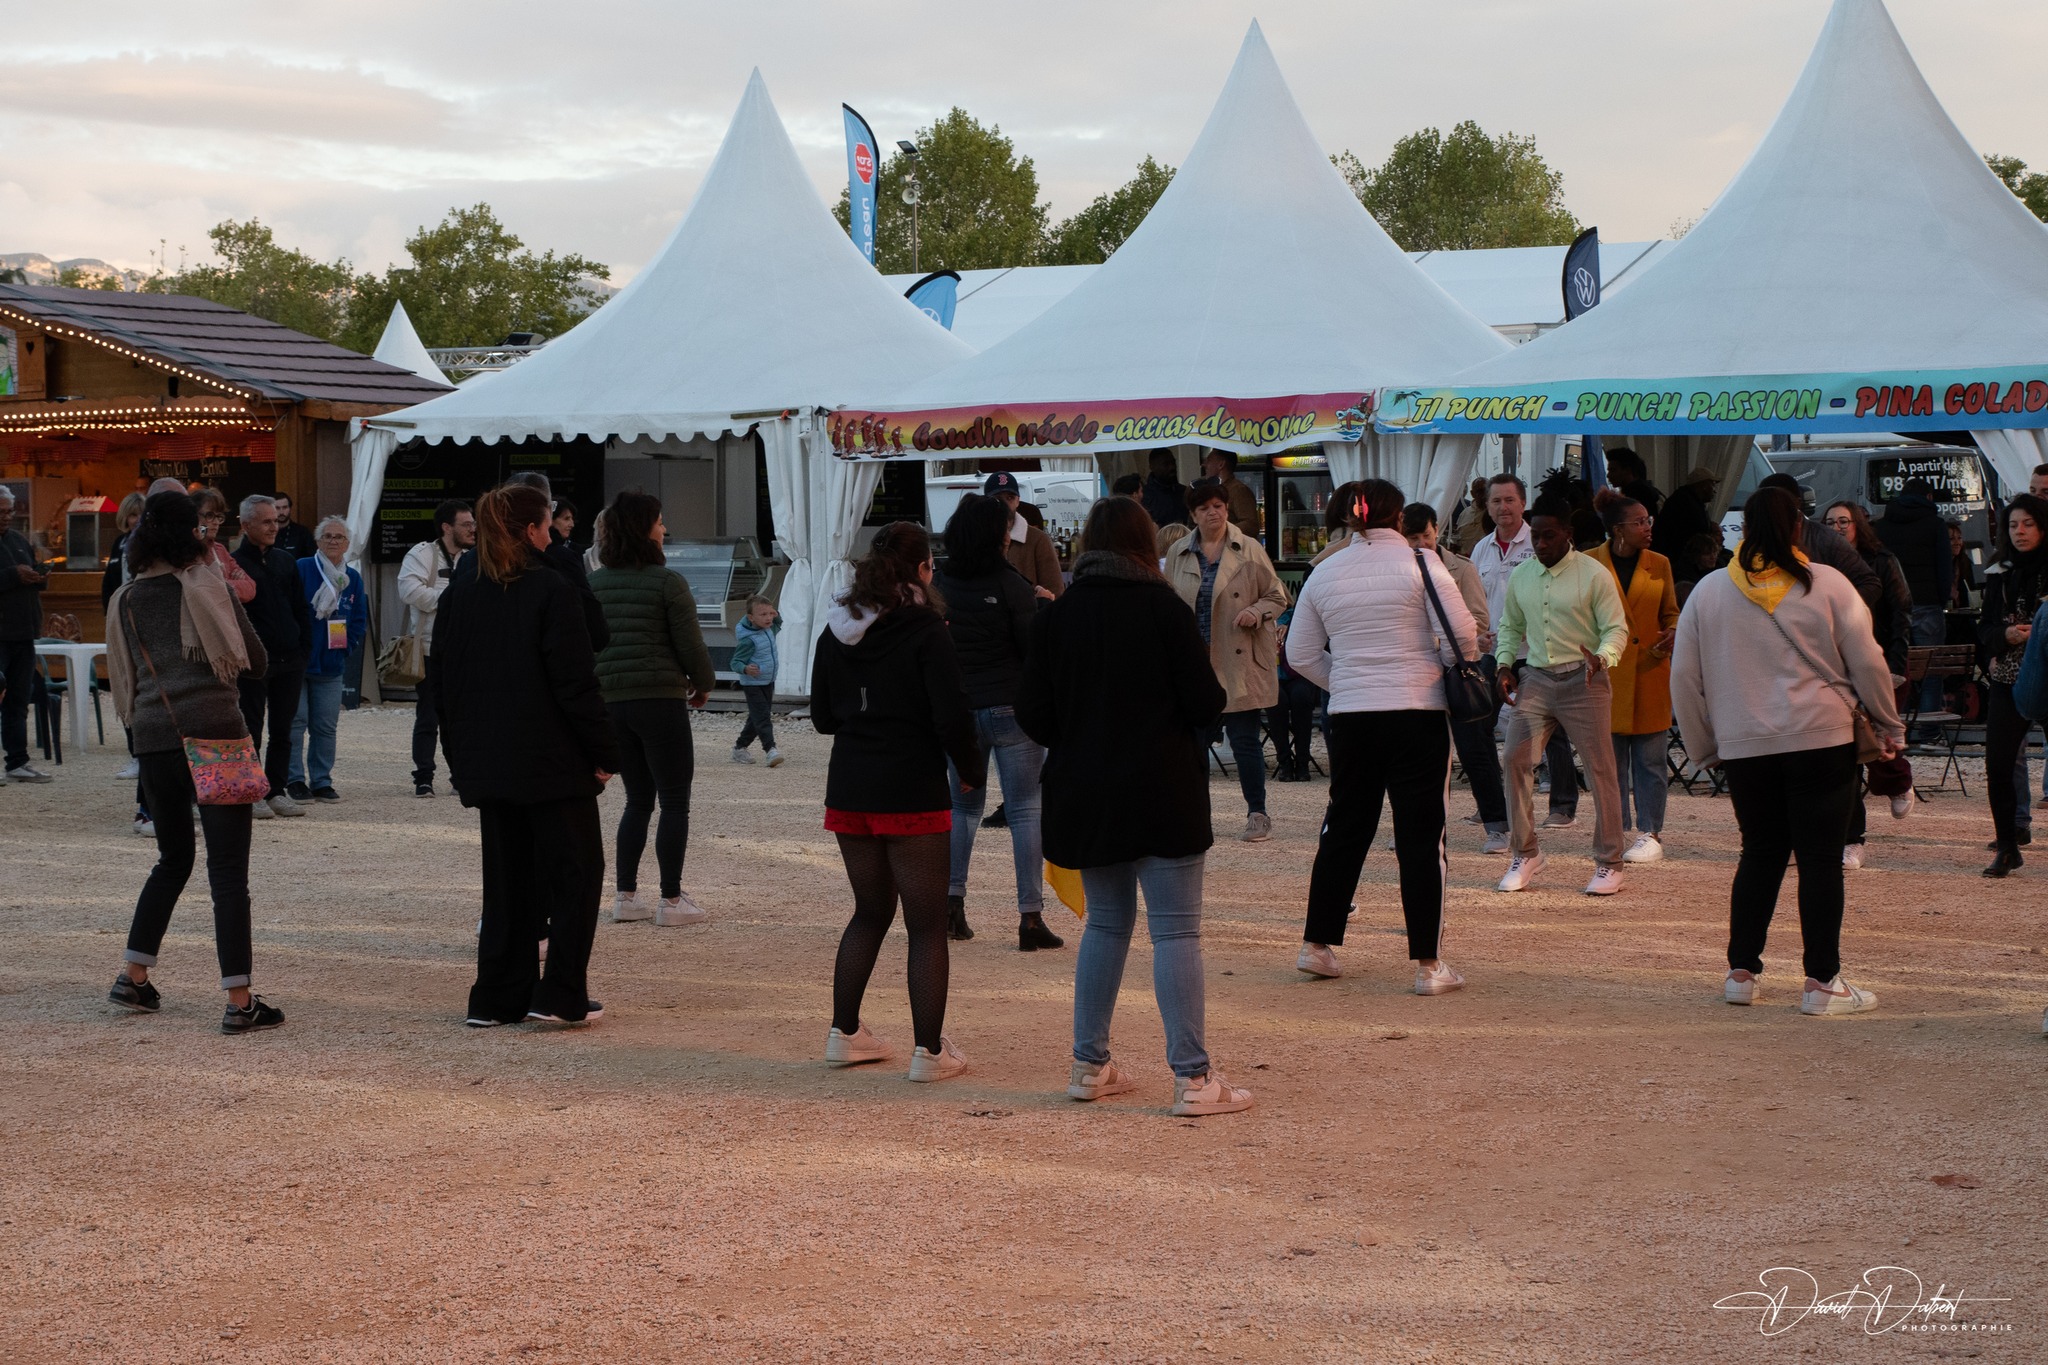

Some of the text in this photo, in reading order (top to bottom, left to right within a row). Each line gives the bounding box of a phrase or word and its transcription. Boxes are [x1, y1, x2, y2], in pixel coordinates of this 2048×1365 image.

[1412, 397, 1443, 422] TI
[1445, 395, 1548, 422] PUNCH
[1575, 391, 1682, 422] PUNCH
[1688, 388, 1822, 422] PASSION
[1855, 384, 1934, 418] PINA
[1943, 379, 2048, 415] COLAD
[1116, 414, 1197, 441] accras
[1199, 404, 1236, 439] de
[1897, 458, 1957, 475] À partir de
[423, 479, 439, 488] BOX
[382, 510, 422, 518] BOISSONS
